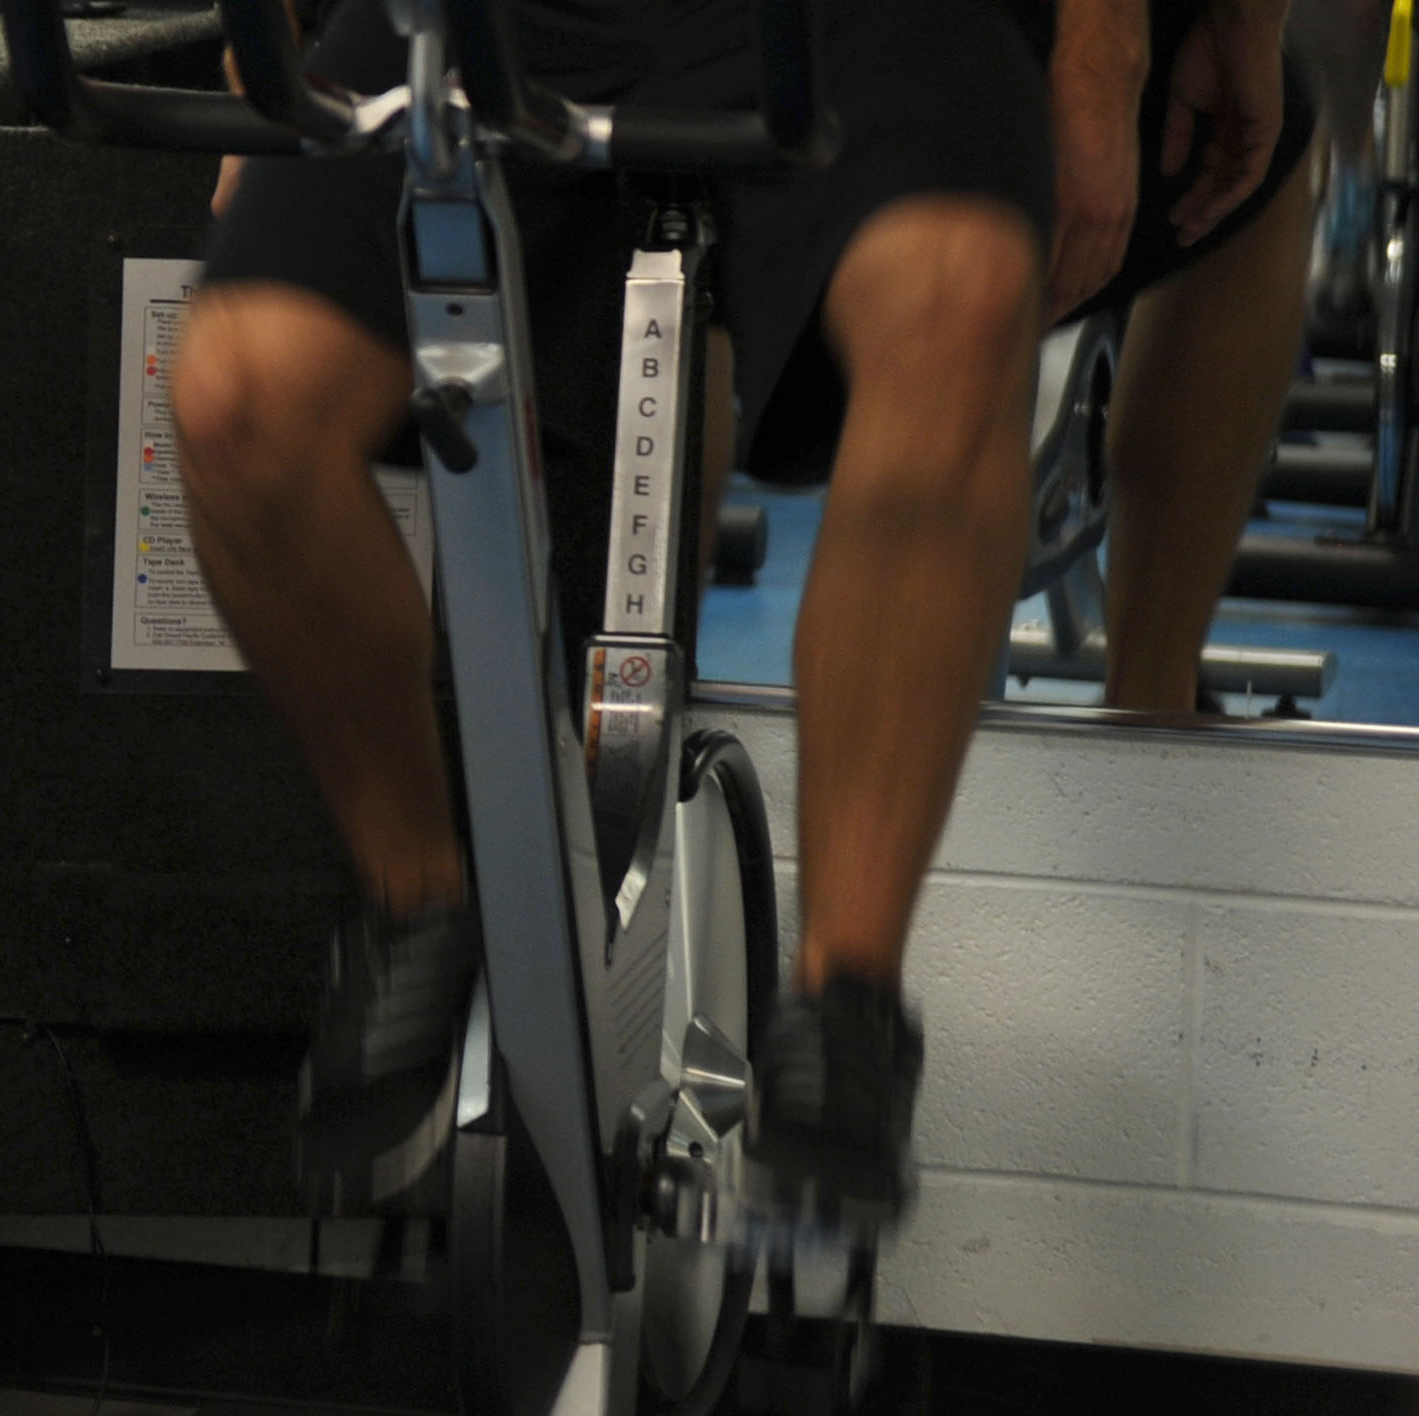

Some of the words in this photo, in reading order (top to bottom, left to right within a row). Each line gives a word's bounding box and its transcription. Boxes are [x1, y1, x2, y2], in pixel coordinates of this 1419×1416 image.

[644, 319, 662, 339] A
[642, 358, 659, 378] B
[639, 397, 656, 417] C
[636, 436, 654, 456] D
[634, 475, 650, 496] E
[632, 515, 648, 536] F
[628, 554, 647, 575] G
[626, 594, 644, 614] H
